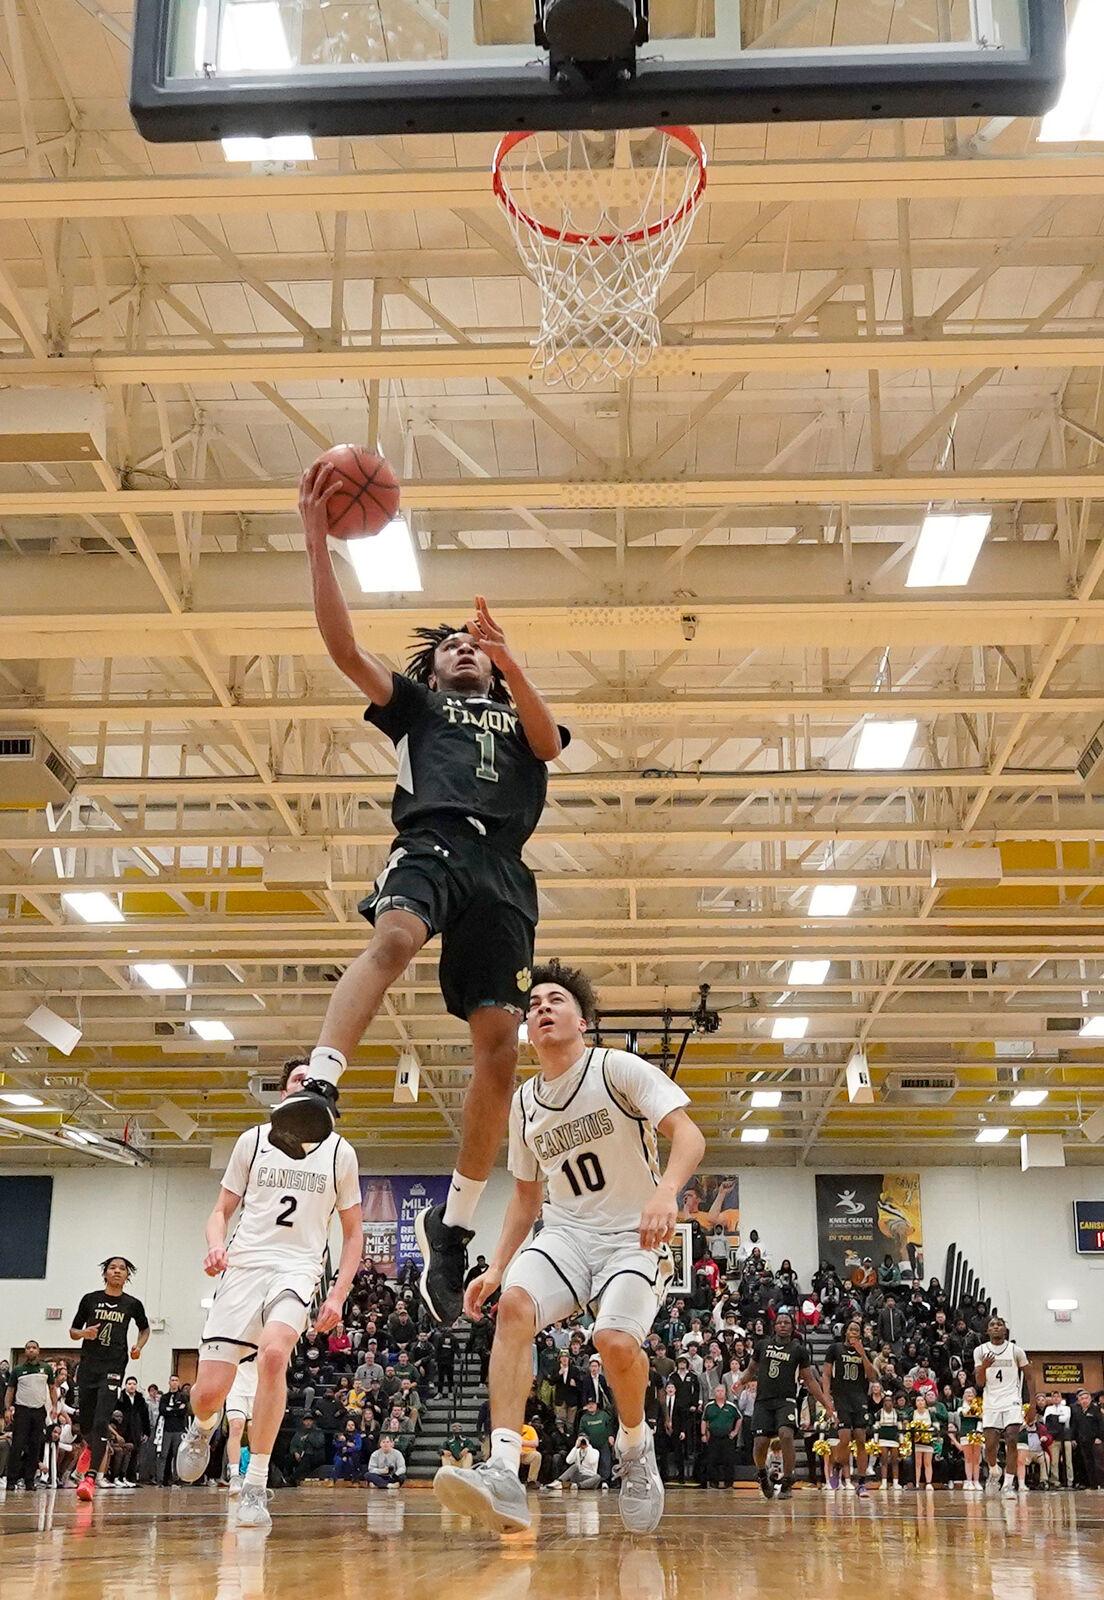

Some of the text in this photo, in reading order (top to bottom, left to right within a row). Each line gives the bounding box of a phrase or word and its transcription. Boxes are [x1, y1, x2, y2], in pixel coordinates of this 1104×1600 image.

[443, 705, 518, 734] TIMON
[475, 730, 498, 782] 1
[534, 1108, 614, 1160] CANISIUS
[257, 1167, 327, 1194] CANISIUS
[562, 1152, 606, 1196] 10
[276, 1195, 297, 1227] 2
[402, 1198, 433, 1209] MILK
[366, 1235, 390, 1245] MILK
[94, 1309, 125, 1323] TIMON
[98, 1322, 113, 1346] 4
[765, 1350, 791, 1361] TIMON
[768, 1360, 781, 1379] 5
[843, 1363, 859, 1381] 10
[995, 1369, 1003, 1383] 4
